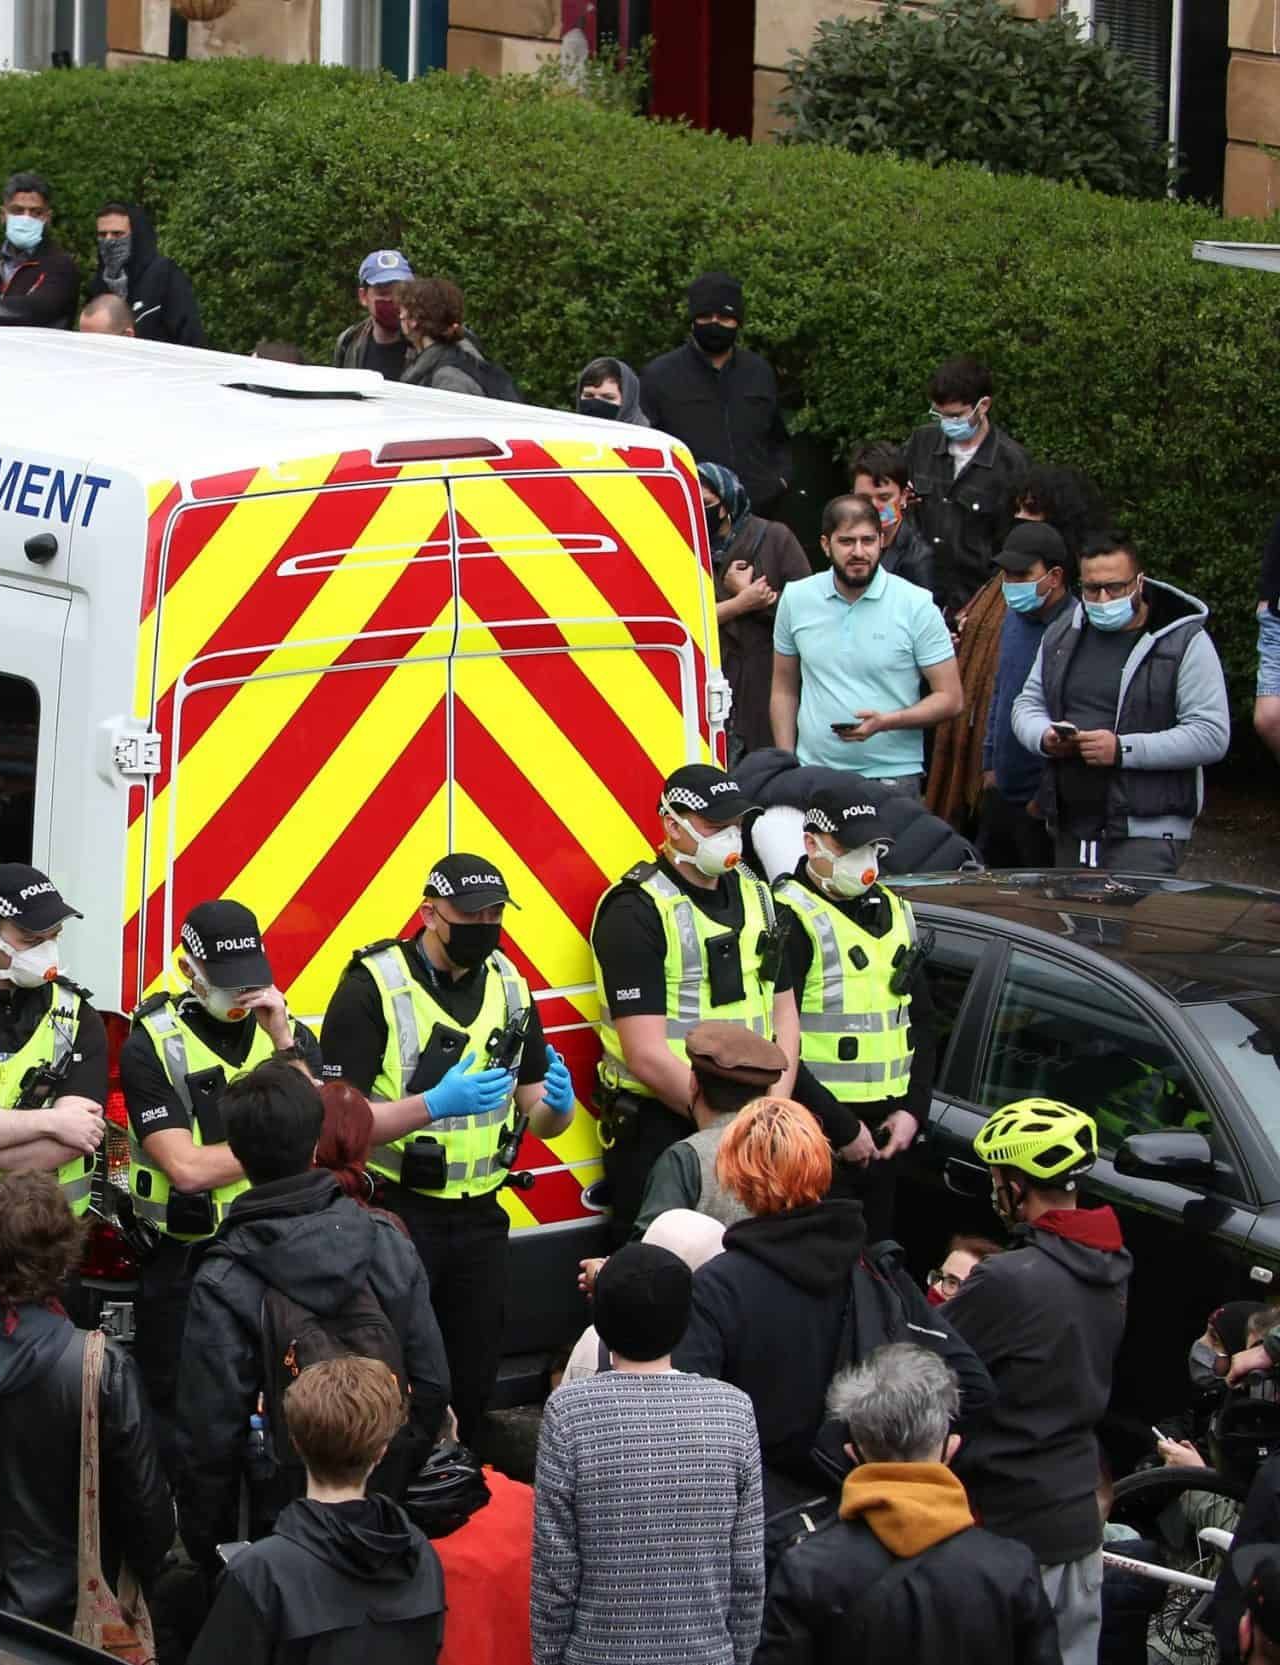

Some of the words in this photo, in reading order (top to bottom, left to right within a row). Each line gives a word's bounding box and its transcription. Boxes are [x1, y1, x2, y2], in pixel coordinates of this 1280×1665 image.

[461, 875, 502, 886] POLICE
[216, 937, 257, 952] POLICE
[142, 1106, 167, 1118] POLICE
